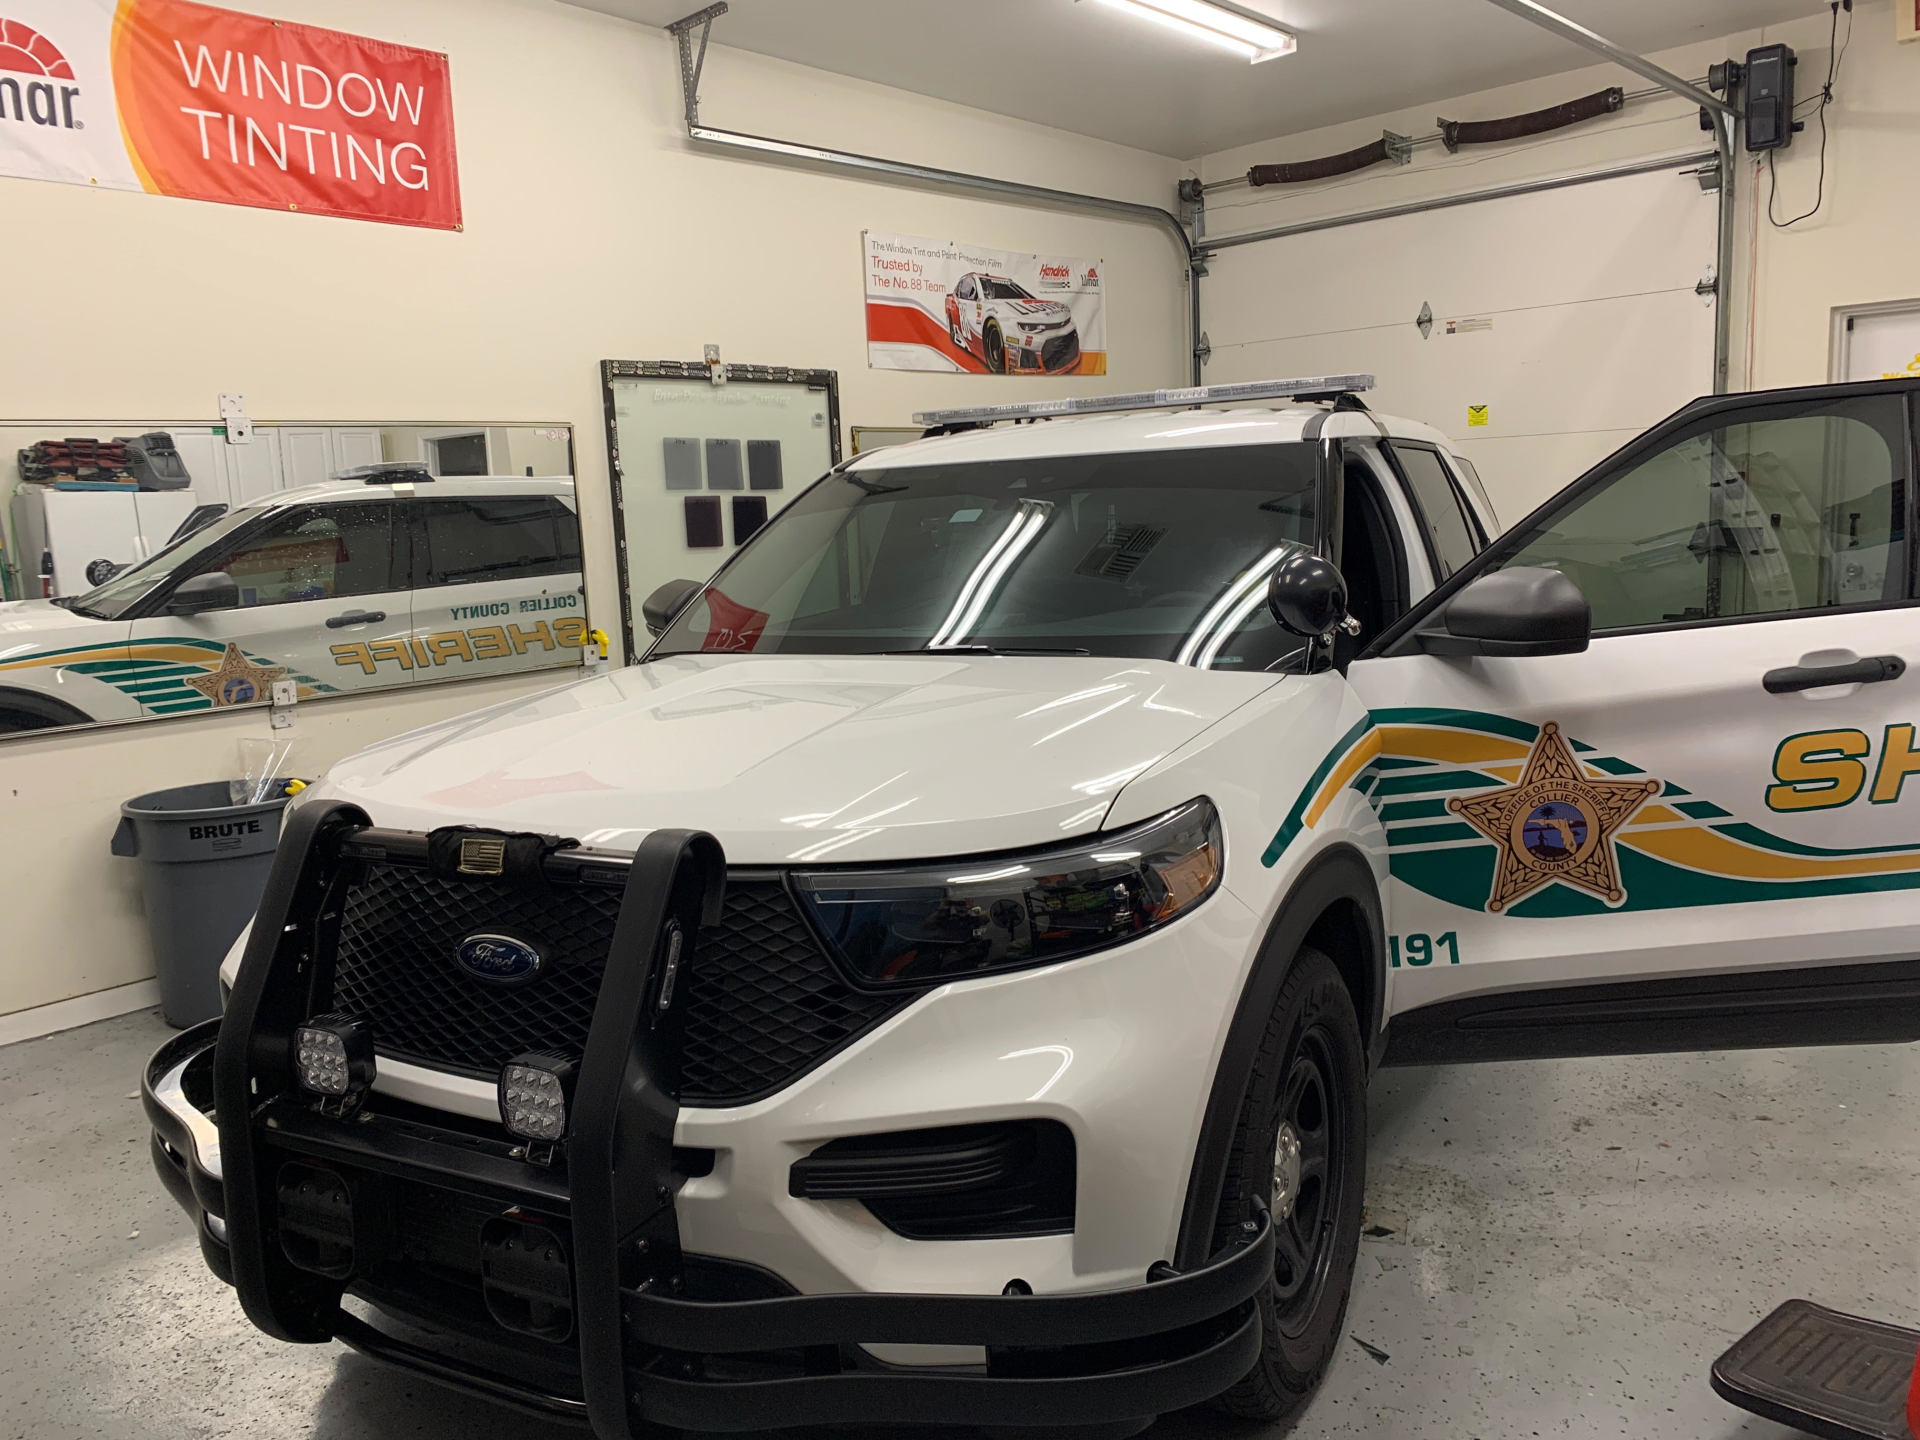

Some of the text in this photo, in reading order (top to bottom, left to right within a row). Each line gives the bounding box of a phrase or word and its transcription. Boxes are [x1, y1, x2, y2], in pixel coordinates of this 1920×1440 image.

[173, 40, 425, 126] WINDOW
[180, 106, 429, 191] TINTING
[871, 256, 923, 276] Trusted by
[872, 241, 885, 251] The
[886, 243, 912, 255] Window
[913, 247, 926, 256] Tint
[928, 249, 940, 258] and
[942, 250, 957, 260] Paint
[988, 258, 1002, 268] Film
[872, 274, 946, 292] The No. 88 Team
[1504, 781, 1609, 821] OFFICE OF THE SHERIFF
[1529, 793, 1580, 809] COLLIER
[189, 820, 262, 840] BRUTE
[1531, 856, 1578, 871] COUNTY
[472, 943, 517, 970] Ford
[1389, 931, 1460, 968] 191
